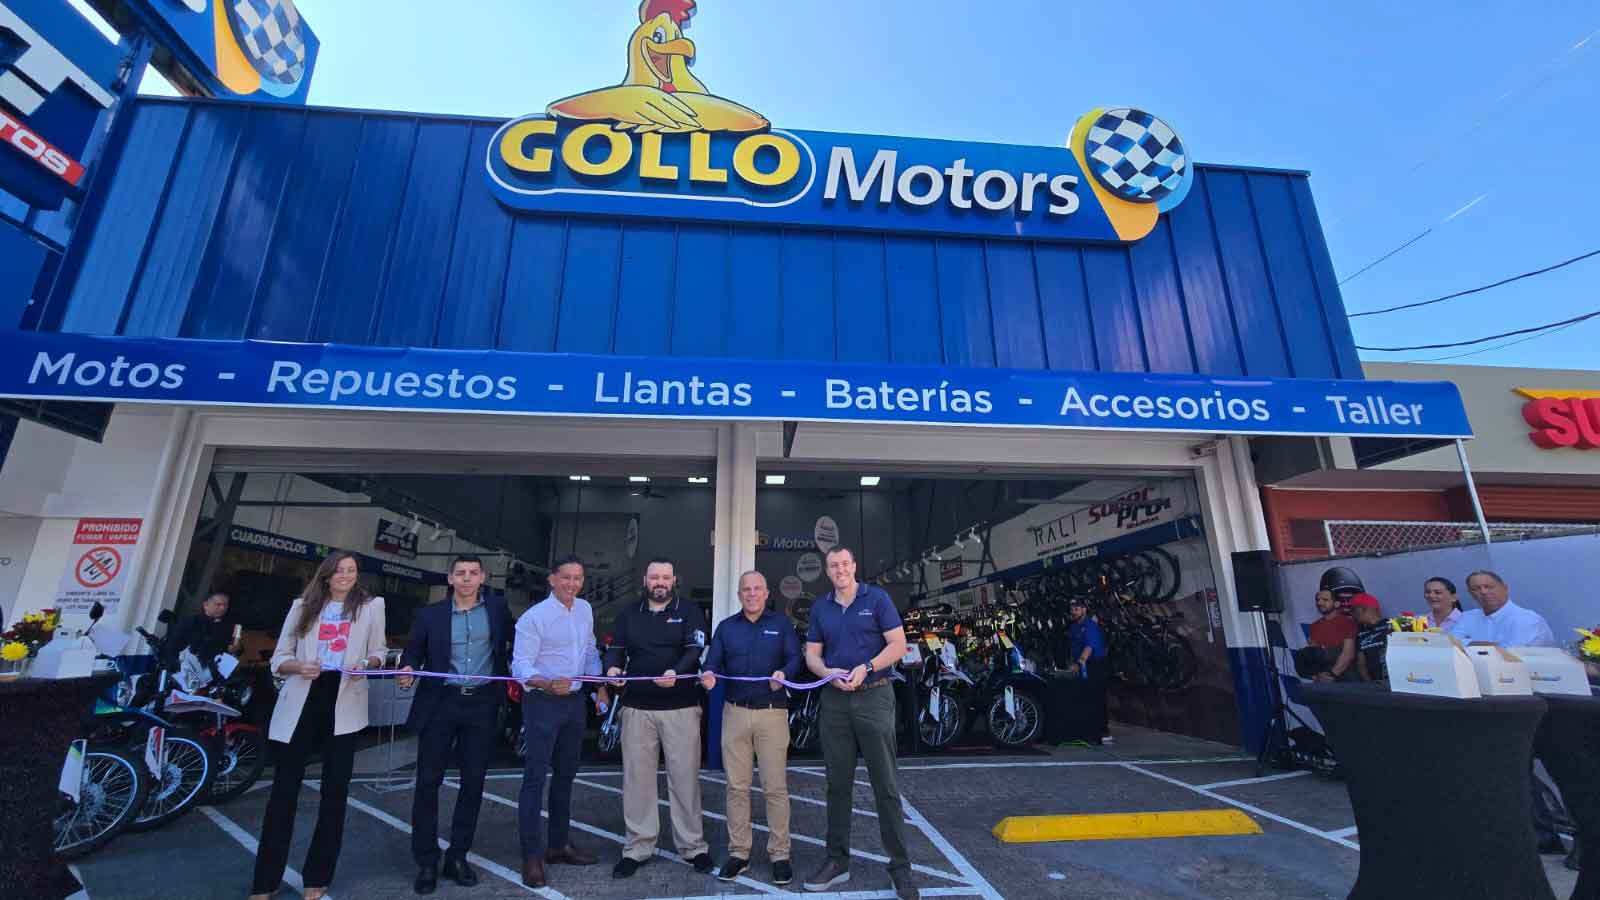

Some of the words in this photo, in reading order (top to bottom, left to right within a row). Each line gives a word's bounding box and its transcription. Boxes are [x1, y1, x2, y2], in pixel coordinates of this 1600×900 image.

[500, 119, 800, 186] GOLLO
[824, 146, 1080, 215] Motors
[28, 351, 187, 389] Motos
[267, 360, 517, 401] Repuestos
[595, 372, 752, 406] Llantas
[825, 379, 993, 413] Baterías
[1060, 386, 1270, 421] Accesorios
[1325, 395, 1423, 425] Taller
[80, 523, 139, 532] PROHIBIDO
